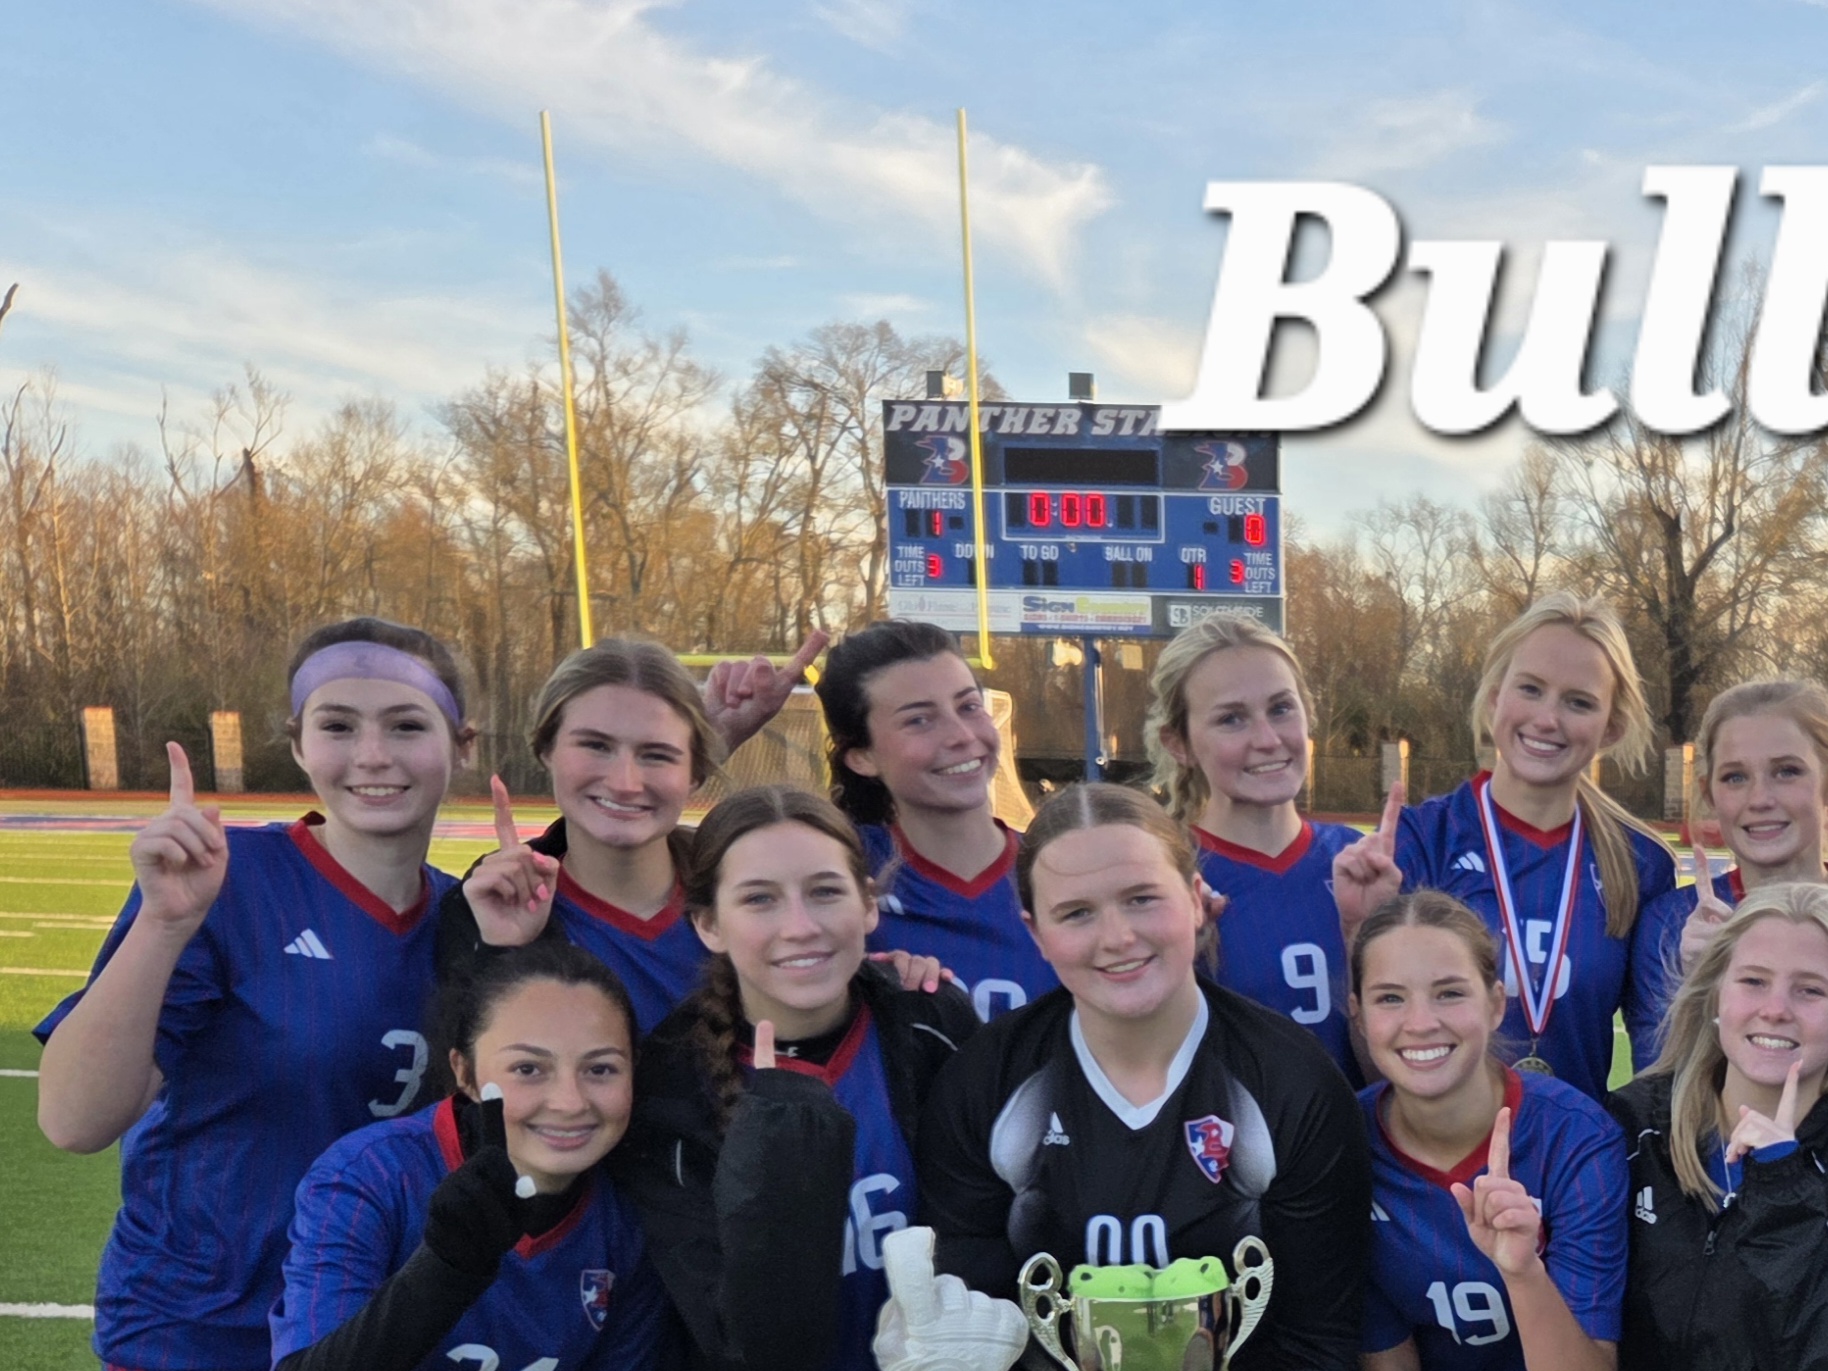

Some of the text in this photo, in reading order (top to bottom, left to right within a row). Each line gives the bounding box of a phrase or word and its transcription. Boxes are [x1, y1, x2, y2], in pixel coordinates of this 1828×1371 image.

[886, 404, 1082, 435] PANTHER
[899, 491, 966, 510] PANTHERS
[1209, 496, 1266, 515] GUEST
[932, 510, 943, 537] 1
[1244, 513, 1266, 546] 0
[896, 546, 925, 559] TIME
[954, 543, 994, 559] DON
[1018, 545, 1059, 560] TO GO
[1104, 546, 1153, 562] BALL ON
[1244, 553, 1273, 566] TIME
[894, 560, 925, 573] OUTS
[926, 553, 943, 579] 3
[1229, 559, 1245, 584] 3
[1244, 567, 1275, 580] OUTS
[897, 574, 925, 586] LEFT
[1244, 581, 1272, 594] LEFT
[1501, 918, 1571, 1000] 15
[1281, 943, 1330, 1024] 9
[367, 1029, 429, 1117] 3
[842, 1172, 908, 1277] 16
[1425, 1281, 1510, 1346] 19
